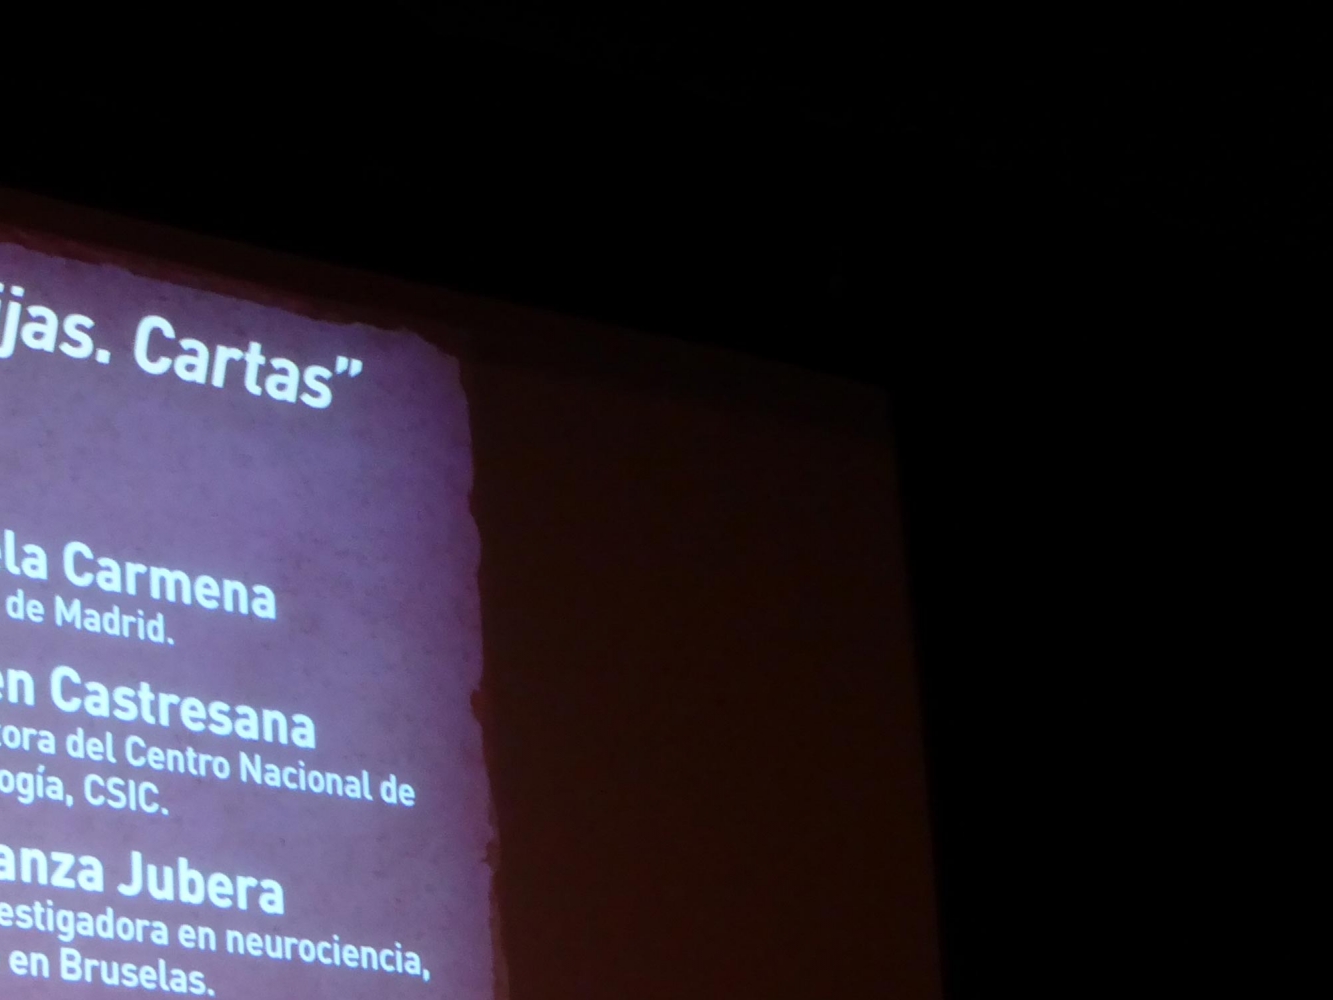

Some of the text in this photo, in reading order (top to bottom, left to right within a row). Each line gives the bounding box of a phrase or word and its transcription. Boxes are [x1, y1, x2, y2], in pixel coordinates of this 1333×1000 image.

[62, 542, 277, 620] Carmena
[5, 590, 45, 624] de
[53, 596, 175, 645] Madrid.
[50, 666, 317, 750] Castresana
[65, 727, 116, 765] del
[125, 738, 232, 781] Centro
[238, 753, 373, 802] Nacional
[378, 773, 416, 807] de
[83, 774, 169, 817] CSIC.
[117, 850, 286, 916] Jubera
[9, 950, 50, 980] en
[59, 947, 216, 997] Bruselas.
[177, 925, 217, 955] en
[225, 929, 432, 983] neurociencia,
